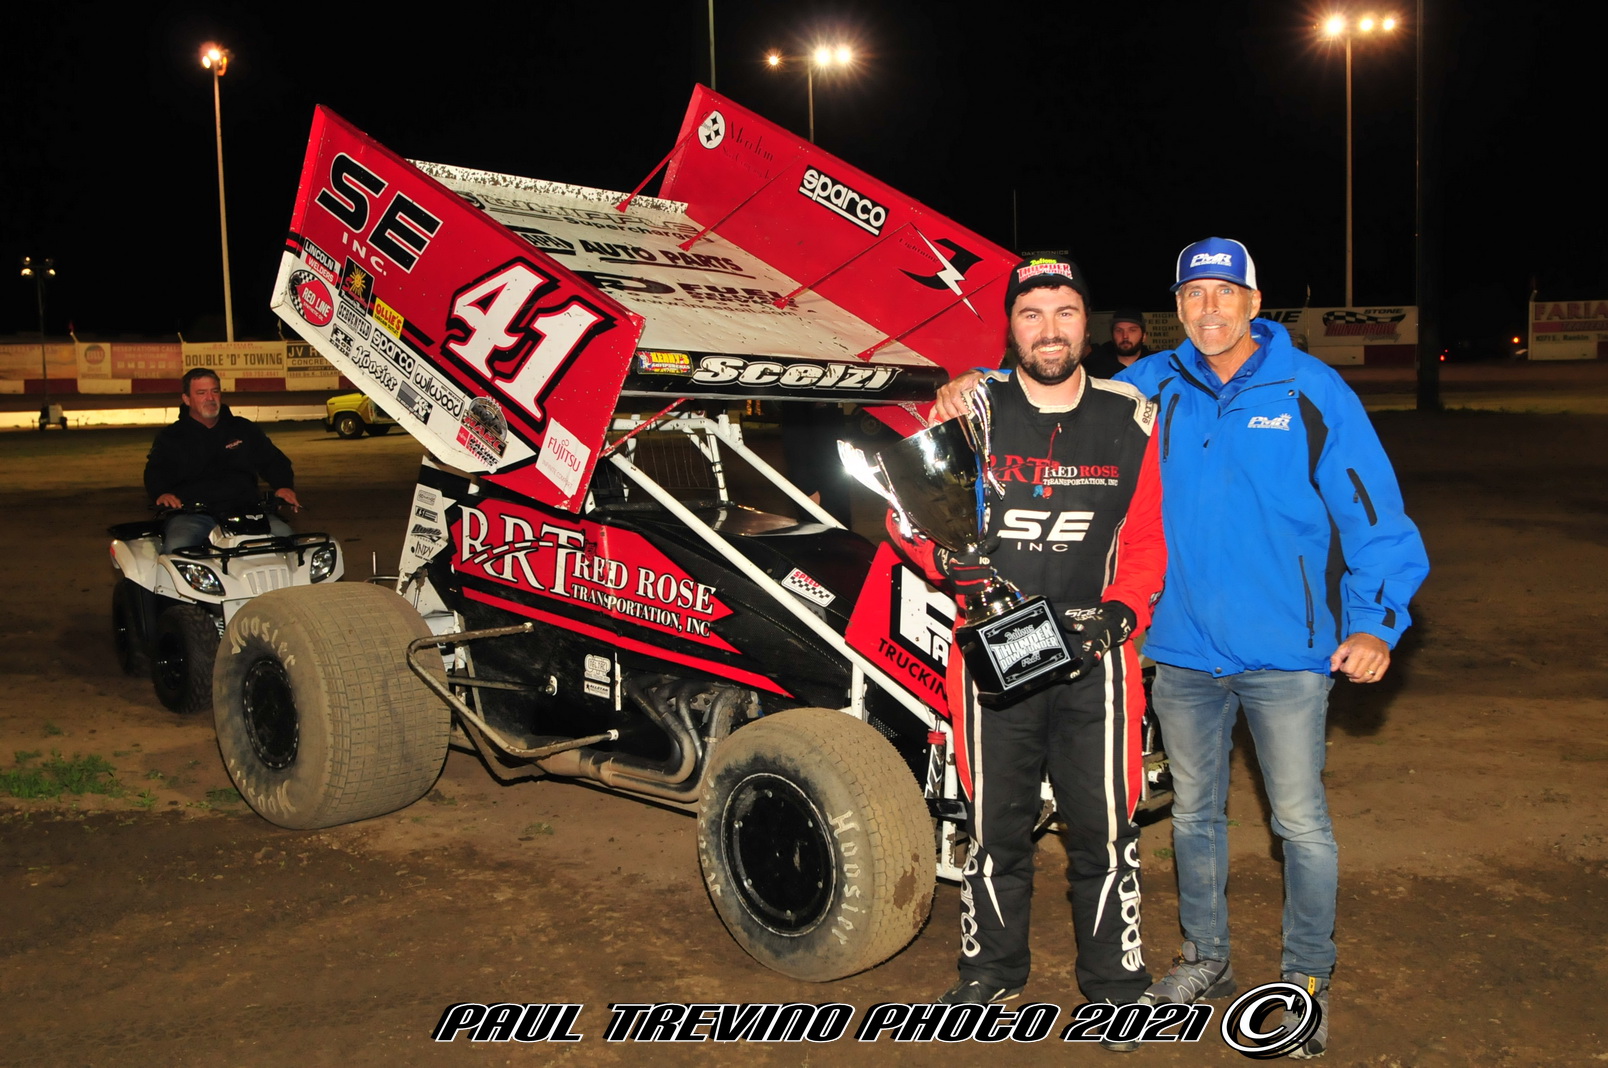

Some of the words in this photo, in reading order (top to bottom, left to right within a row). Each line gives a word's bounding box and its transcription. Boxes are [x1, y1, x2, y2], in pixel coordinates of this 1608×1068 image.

[315, 152, 443, 274] SE
[803, 168, 887, 228] sparco
[563, 217, 714, 243] Supercharges
[304, 241, 335, 271] LINCOLN
[308, 257, 335, 283] WELDERS
[341, 231, 388, 276] INC.
[526, 232, 568, 249] APA
[579, 239, 658, 262] AUTO
[666, 247, 743, 272] PARTS
[301, 287, 317, 305] RED
[315, 297, 332, 318] LINE
[338, 303, 371, 337] SCHOENFELD
[288, 347, 303, 358] JV
[371, 331, 415, 373] sparco
[447, 258, 608, 423] 41
[185, 353, 224, 366] DOUBLE
[244, 352, 283, 366] TOWING
[291, 358, 331, 366] CONCRET
[351, 345, 398, 392] Hoosier
[692, 355, 902, 392] Scelzi
[415, 373, 464, 417] wilwood
[547, 436, 582, 472] FUJITSU
[1043, 465, 1079, 478] RED
[1079, 465, 1120, 478] ROSE
[1107, 478, 1119, 487] INC
[997, 508, 1095, 542] SE
[1017, 541, 1069, 552] INC
[572, 552, 629, 590] RED
[635, 566, 717, 616] ROSE
[792, 570, 822, 588] SPEED
[571, 583, 683, 633] TRANSPORTATION,
[686, 617, 712, 638] INC
[991, 621, 1055, 660] THUNDER
[1000, 647, 1026, 673] DOWN
[1023, 637, 1060, 656] UNDER
[879, 637, 949, 700] TRUCKIN
[1117, 838, 1145, 972] sparc
